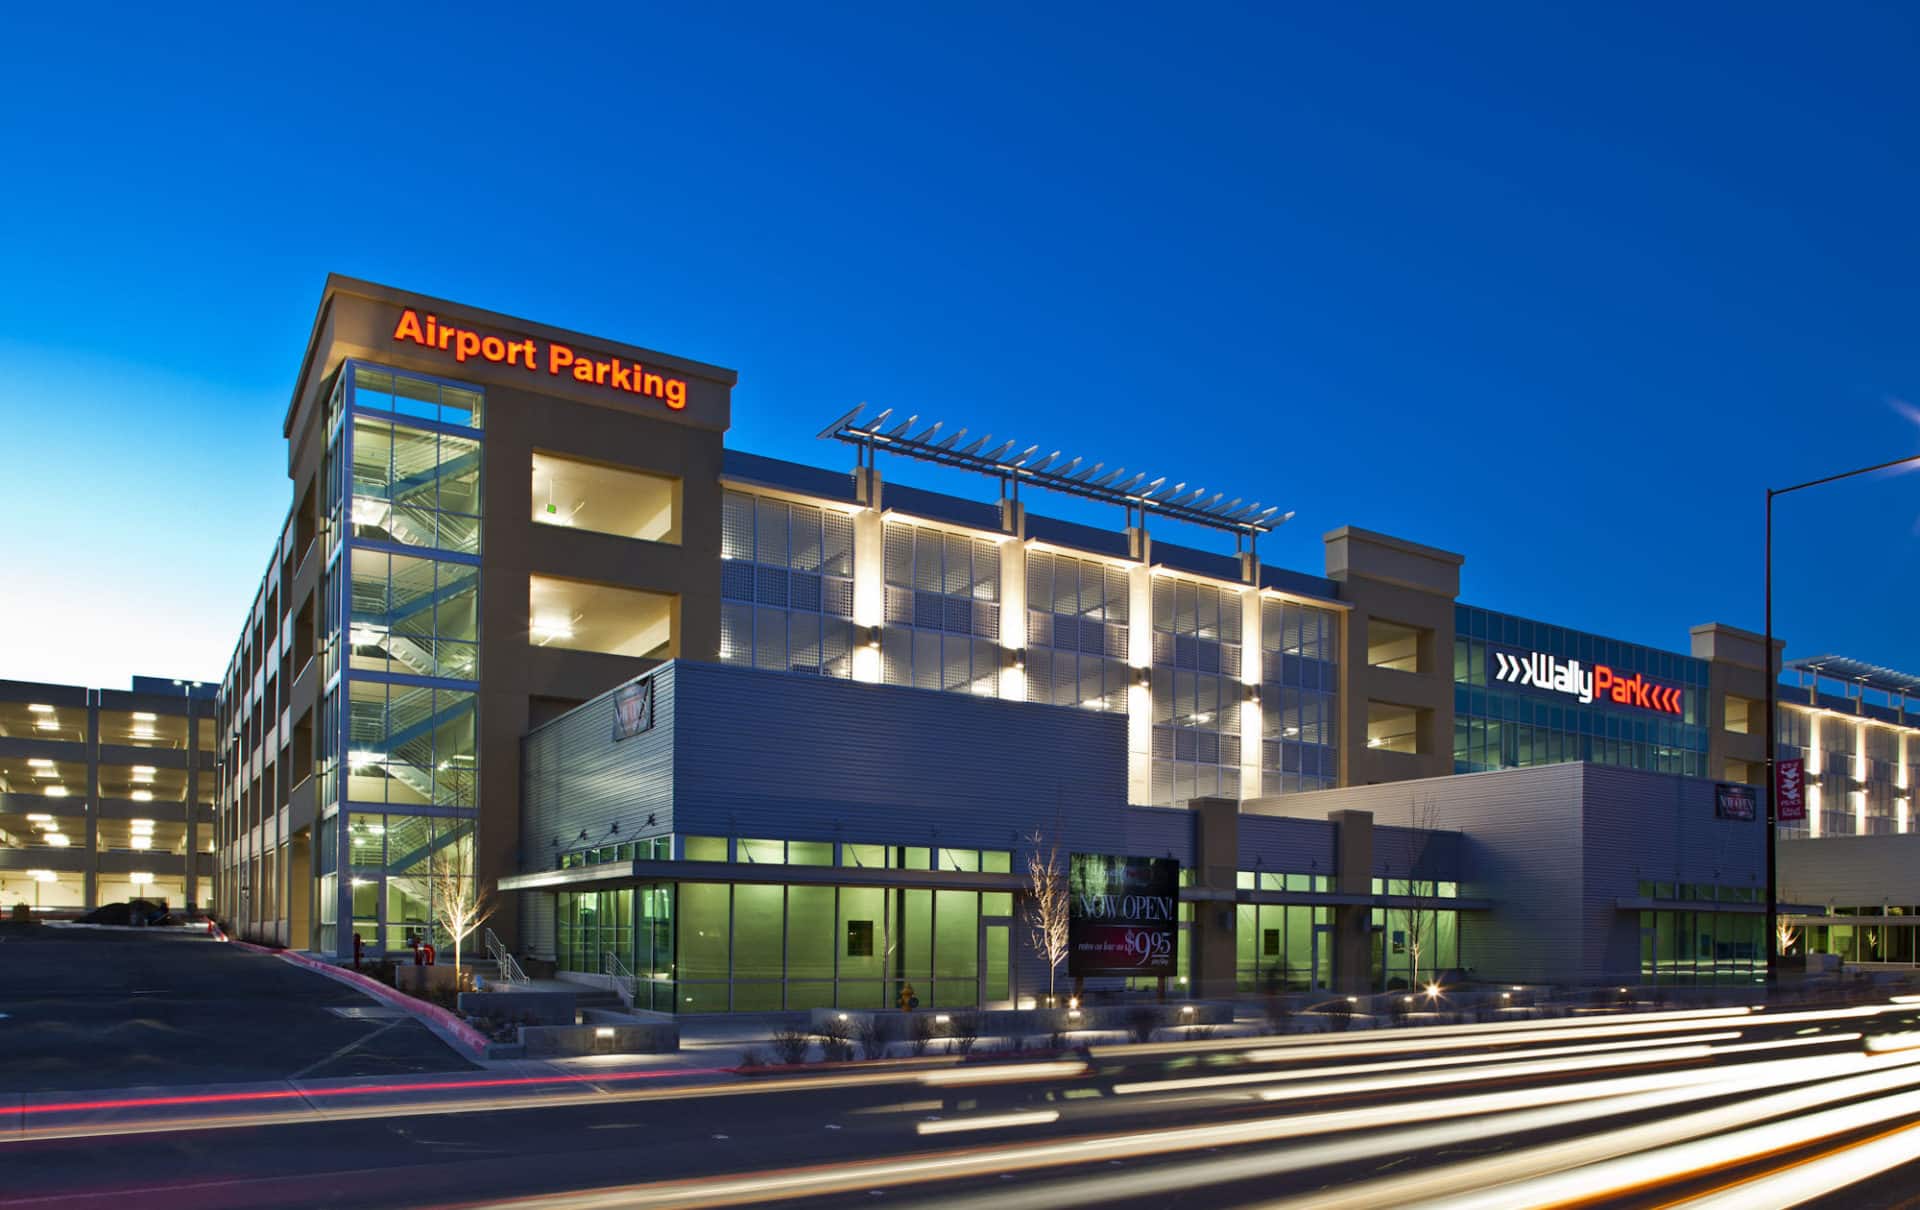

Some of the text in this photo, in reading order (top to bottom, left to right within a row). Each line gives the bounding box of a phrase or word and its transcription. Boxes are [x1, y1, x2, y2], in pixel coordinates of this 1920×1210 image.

[394, 309, 688, 410] Airport Parking
[1079, 893, 1174, 921] NOW OPEN!
